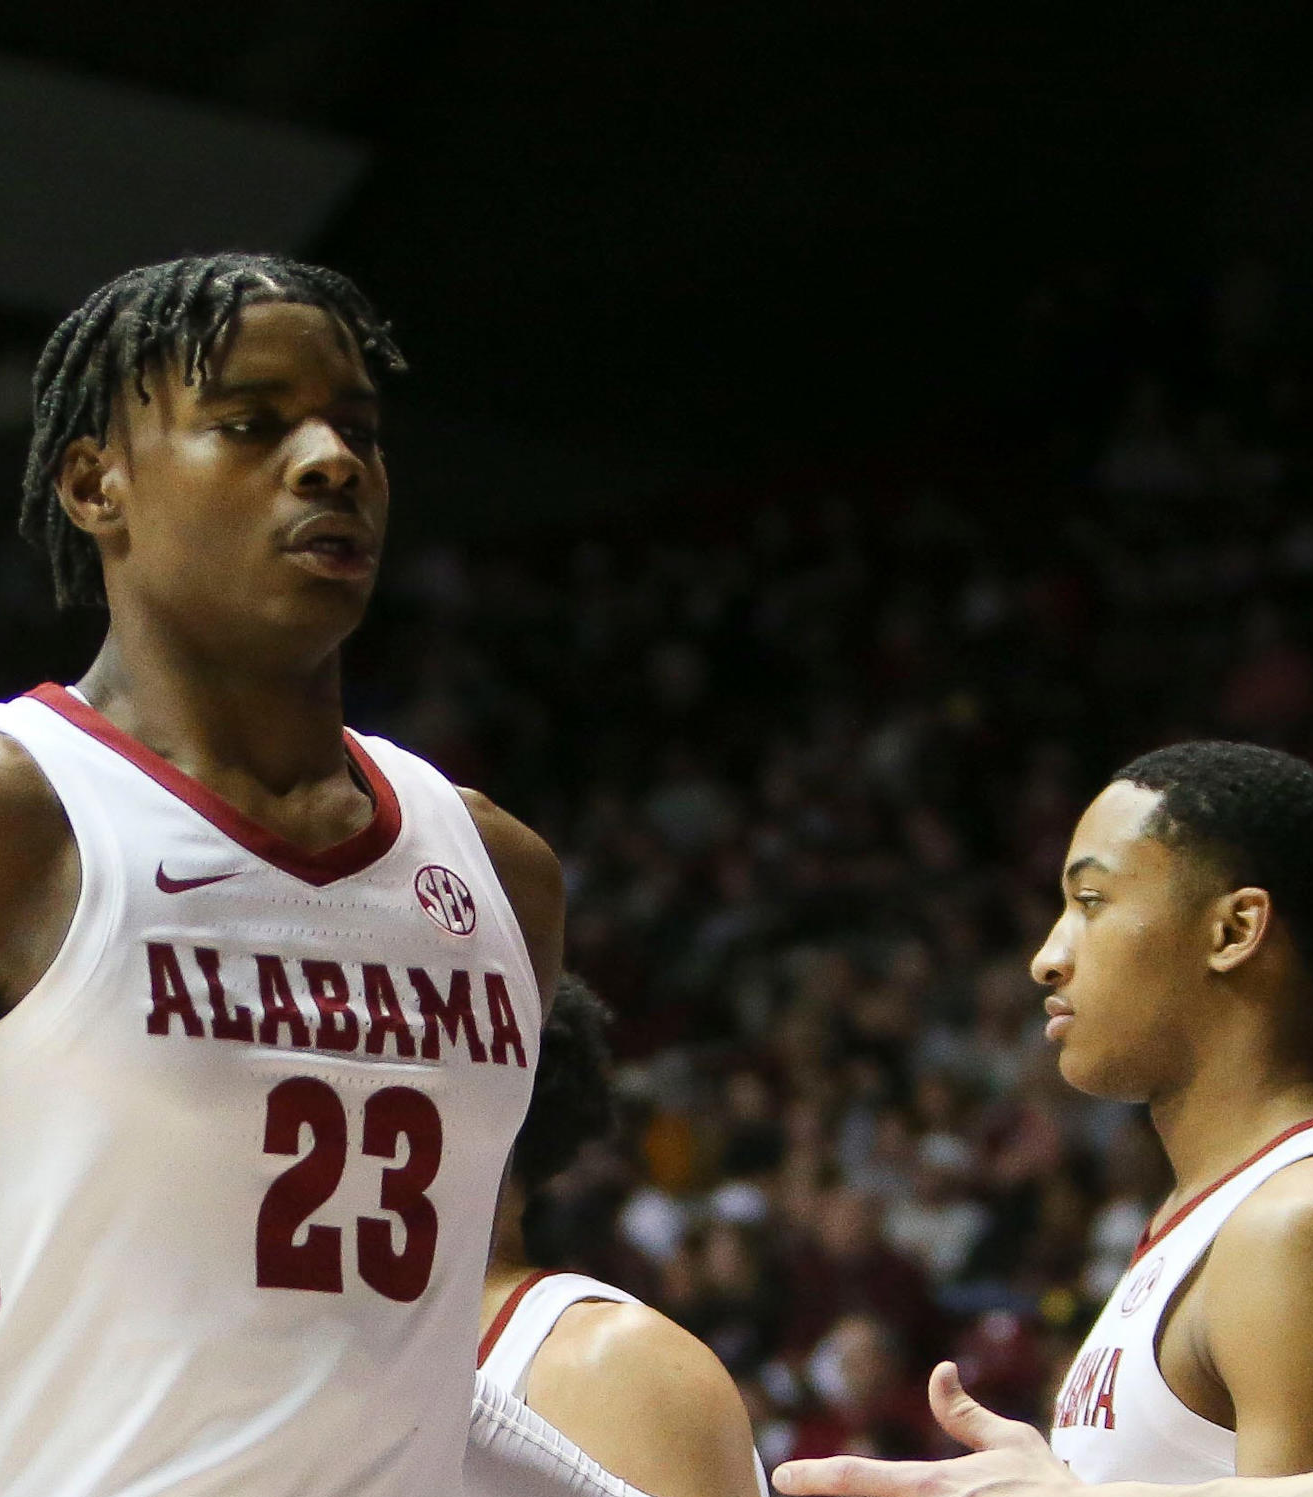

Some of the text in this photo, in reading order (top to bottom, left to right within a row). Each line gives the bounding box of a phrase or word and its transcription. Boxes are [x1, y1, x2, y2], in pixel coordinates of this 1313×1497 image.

[415, 865, 476, 935] SEC
[146, 942, 528, 1068] ALABAMA
[256, 1076, 443, 1303] 23
